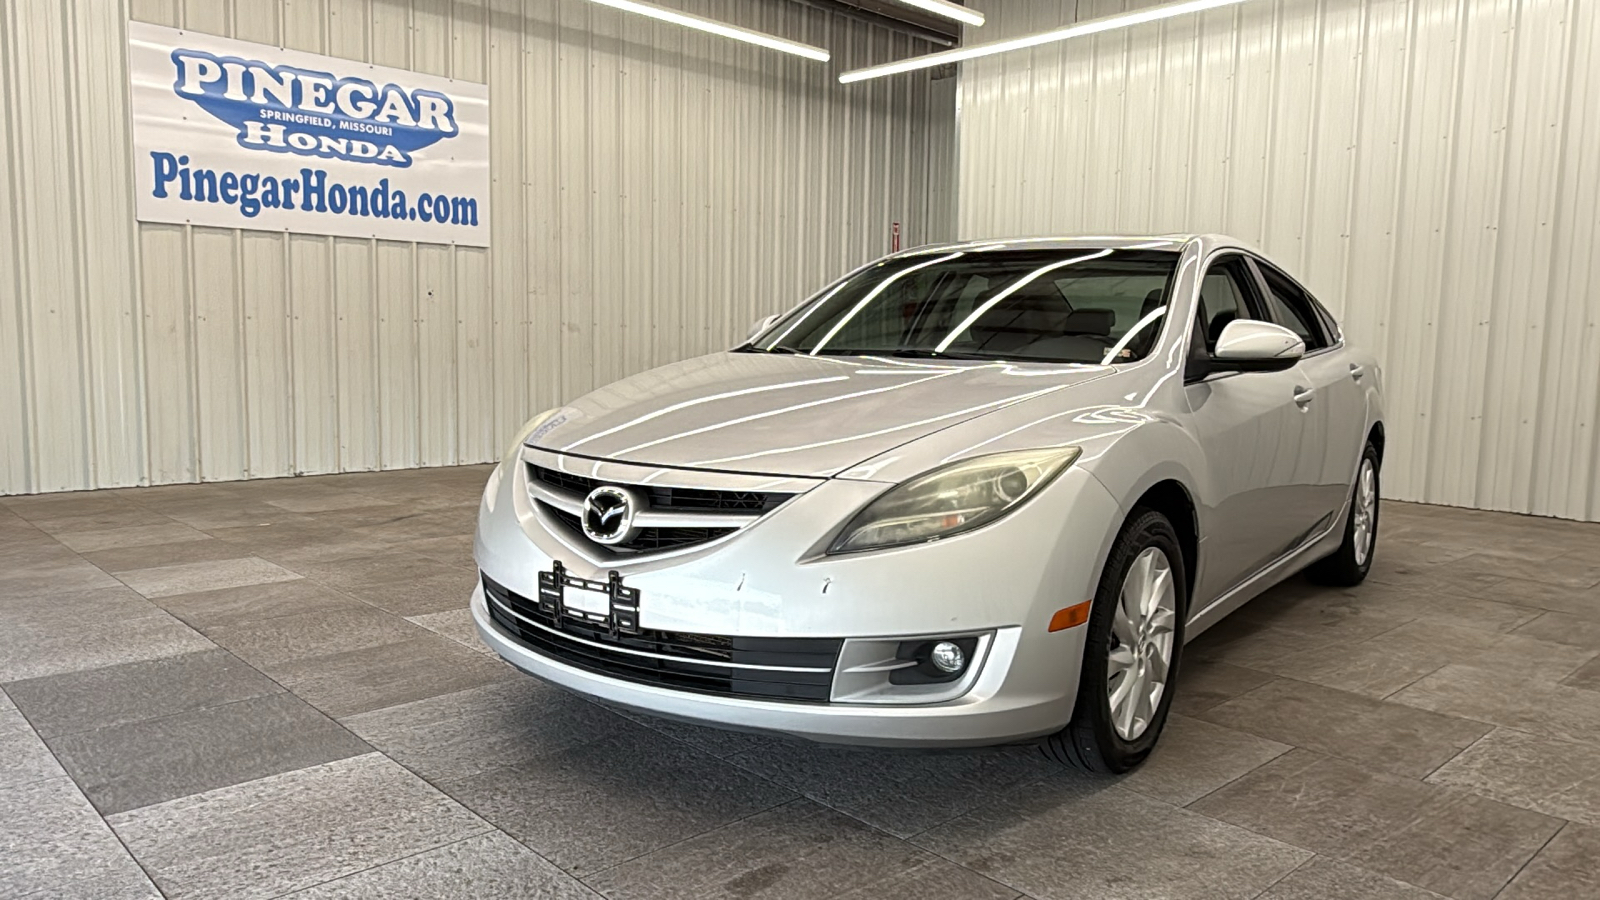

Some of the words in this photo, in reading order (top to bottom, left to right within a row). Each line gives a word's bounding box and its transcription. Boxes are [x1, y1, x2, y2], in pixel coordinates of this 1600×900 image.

[177, 54, 454, 132] PINEGAR
[259, 108, 337, 131] SPRINGFIELD,
[339, 119, 393, 137] MISSOURI
[242, 121, 408, 163] HONDA
[150, 151, 479, 227] PinegarHonda.com
